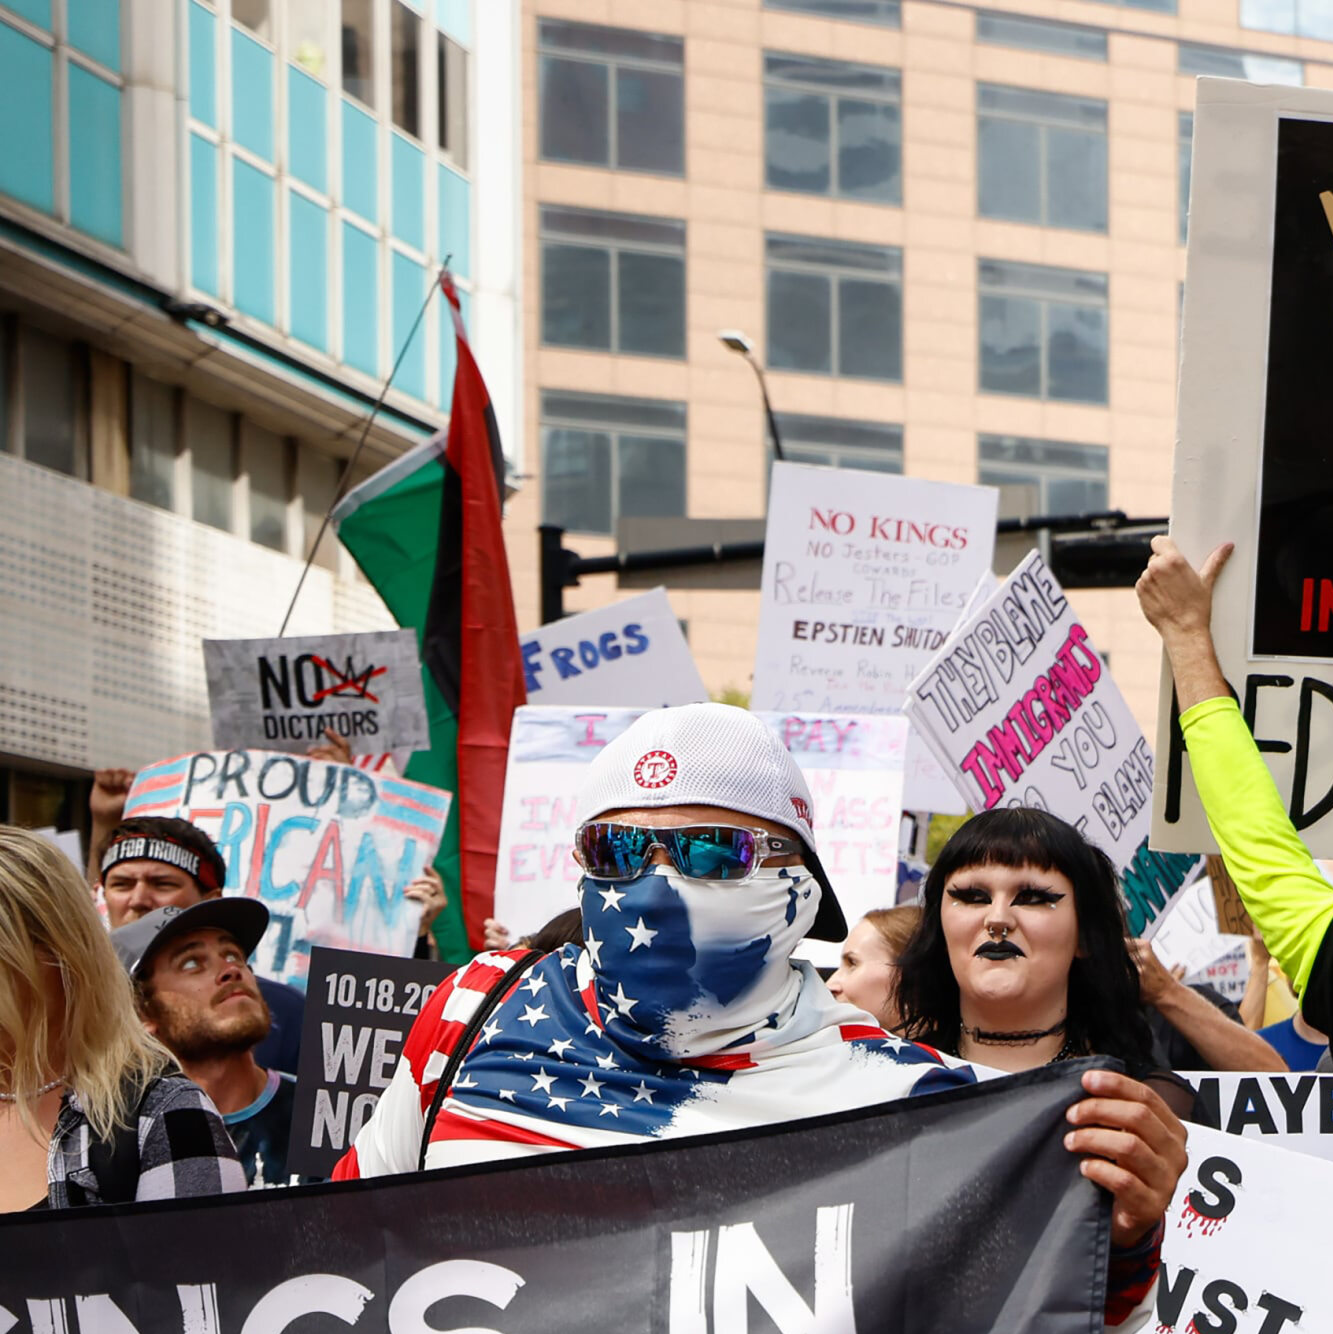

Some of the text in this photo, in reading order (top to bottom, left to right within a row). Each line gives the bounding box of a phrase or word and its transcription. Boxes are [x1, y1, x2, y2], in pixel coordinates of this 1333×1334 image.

[806, 540, 833, 558] NO
[808, 507, 968, 550] NO KINGS
[774, 561, 966, 609] Release The Files
[521, 623, 650, 693] FROGS
[792, 620, 885, 647] EPSTIEN
[916, 555, 1068, 733] THEY BLAME
[258, 653, 324, 710] NO
[263, 710, 379, 740] DICTATORS
[1051, 700, 1117, 791] YOU
[183, 751, 378, 819] PROUD
[148, 838, 200, 876] TROUBLE
[321, 1022, 403, 1089] WE
